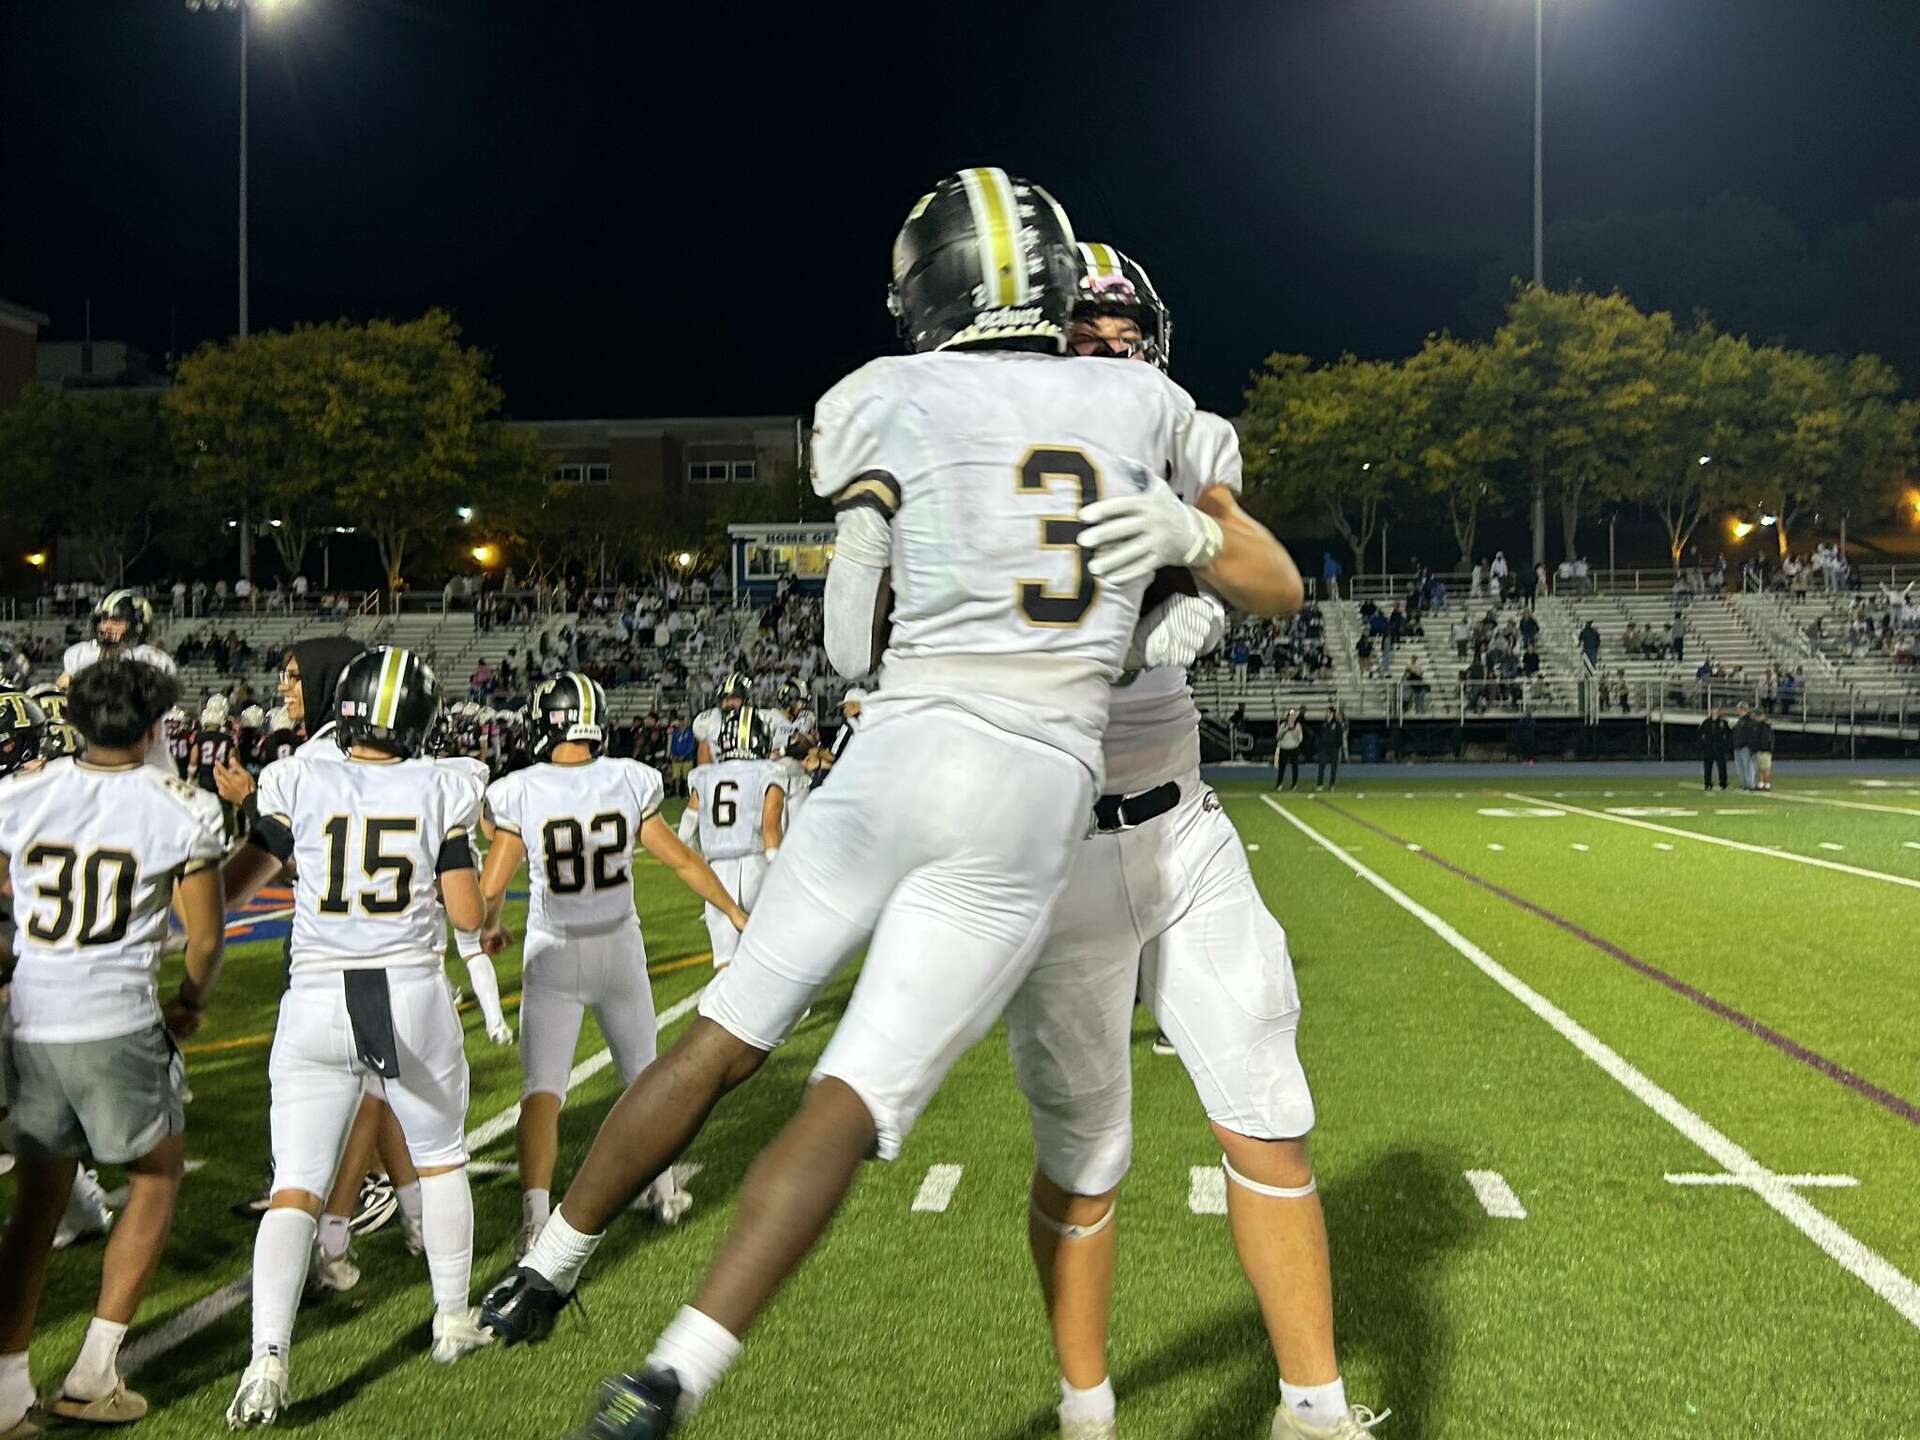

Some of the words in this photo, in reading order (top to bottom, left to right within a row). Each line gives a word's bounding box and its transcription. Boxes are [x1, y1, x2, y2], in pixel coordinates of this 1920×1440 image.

[766, 532, 808, 544] HOME
[1014, 443, 1102, 629] 3
[0, 692, 31, 728] T
[40, 695, 68, 721] T
[49, 723, 79, 753] T
[201, 740, 227, 765] 24
[711, 780, 739, 828] 6
[316, 813, 422, 917] 15
[540, 810, 631, 896] 82
[24, 844, 139, 946] 30
